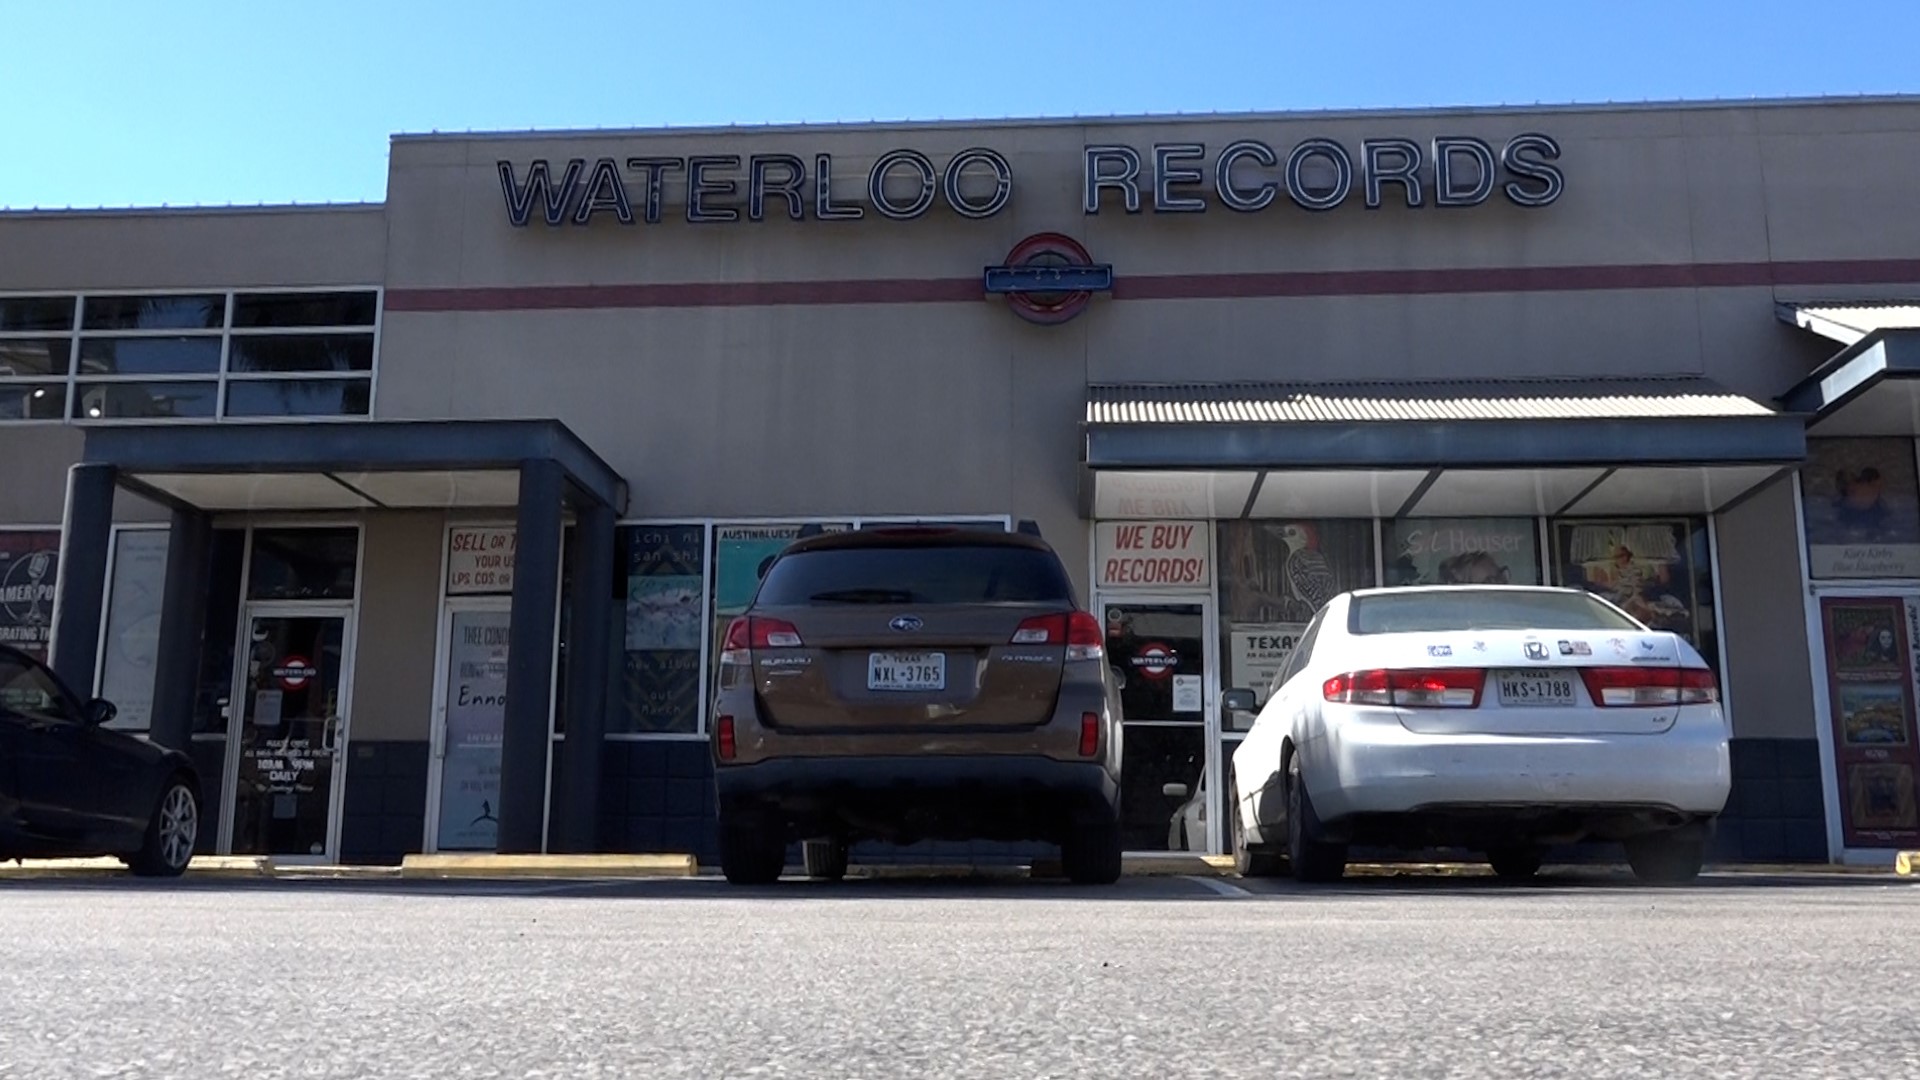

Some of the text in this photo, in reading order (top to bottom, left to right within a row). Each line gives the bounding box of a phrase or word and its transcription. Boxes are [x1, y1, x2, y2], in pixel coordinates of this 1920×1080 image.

[497, 134, 1565, 226] WATERLOO RECORDS
[453, 533, 487, 552] SELL
[491, 535, 506, 549] OR
[1115, 525, 1194, 550] WE BUY
[1448, 529, 1526, 553] Houser
[475, 554, 501, 568] YOUR
[1104, 558, 1204, 583] RECORDS!
[894, 655, 921, 663] TEXAS
